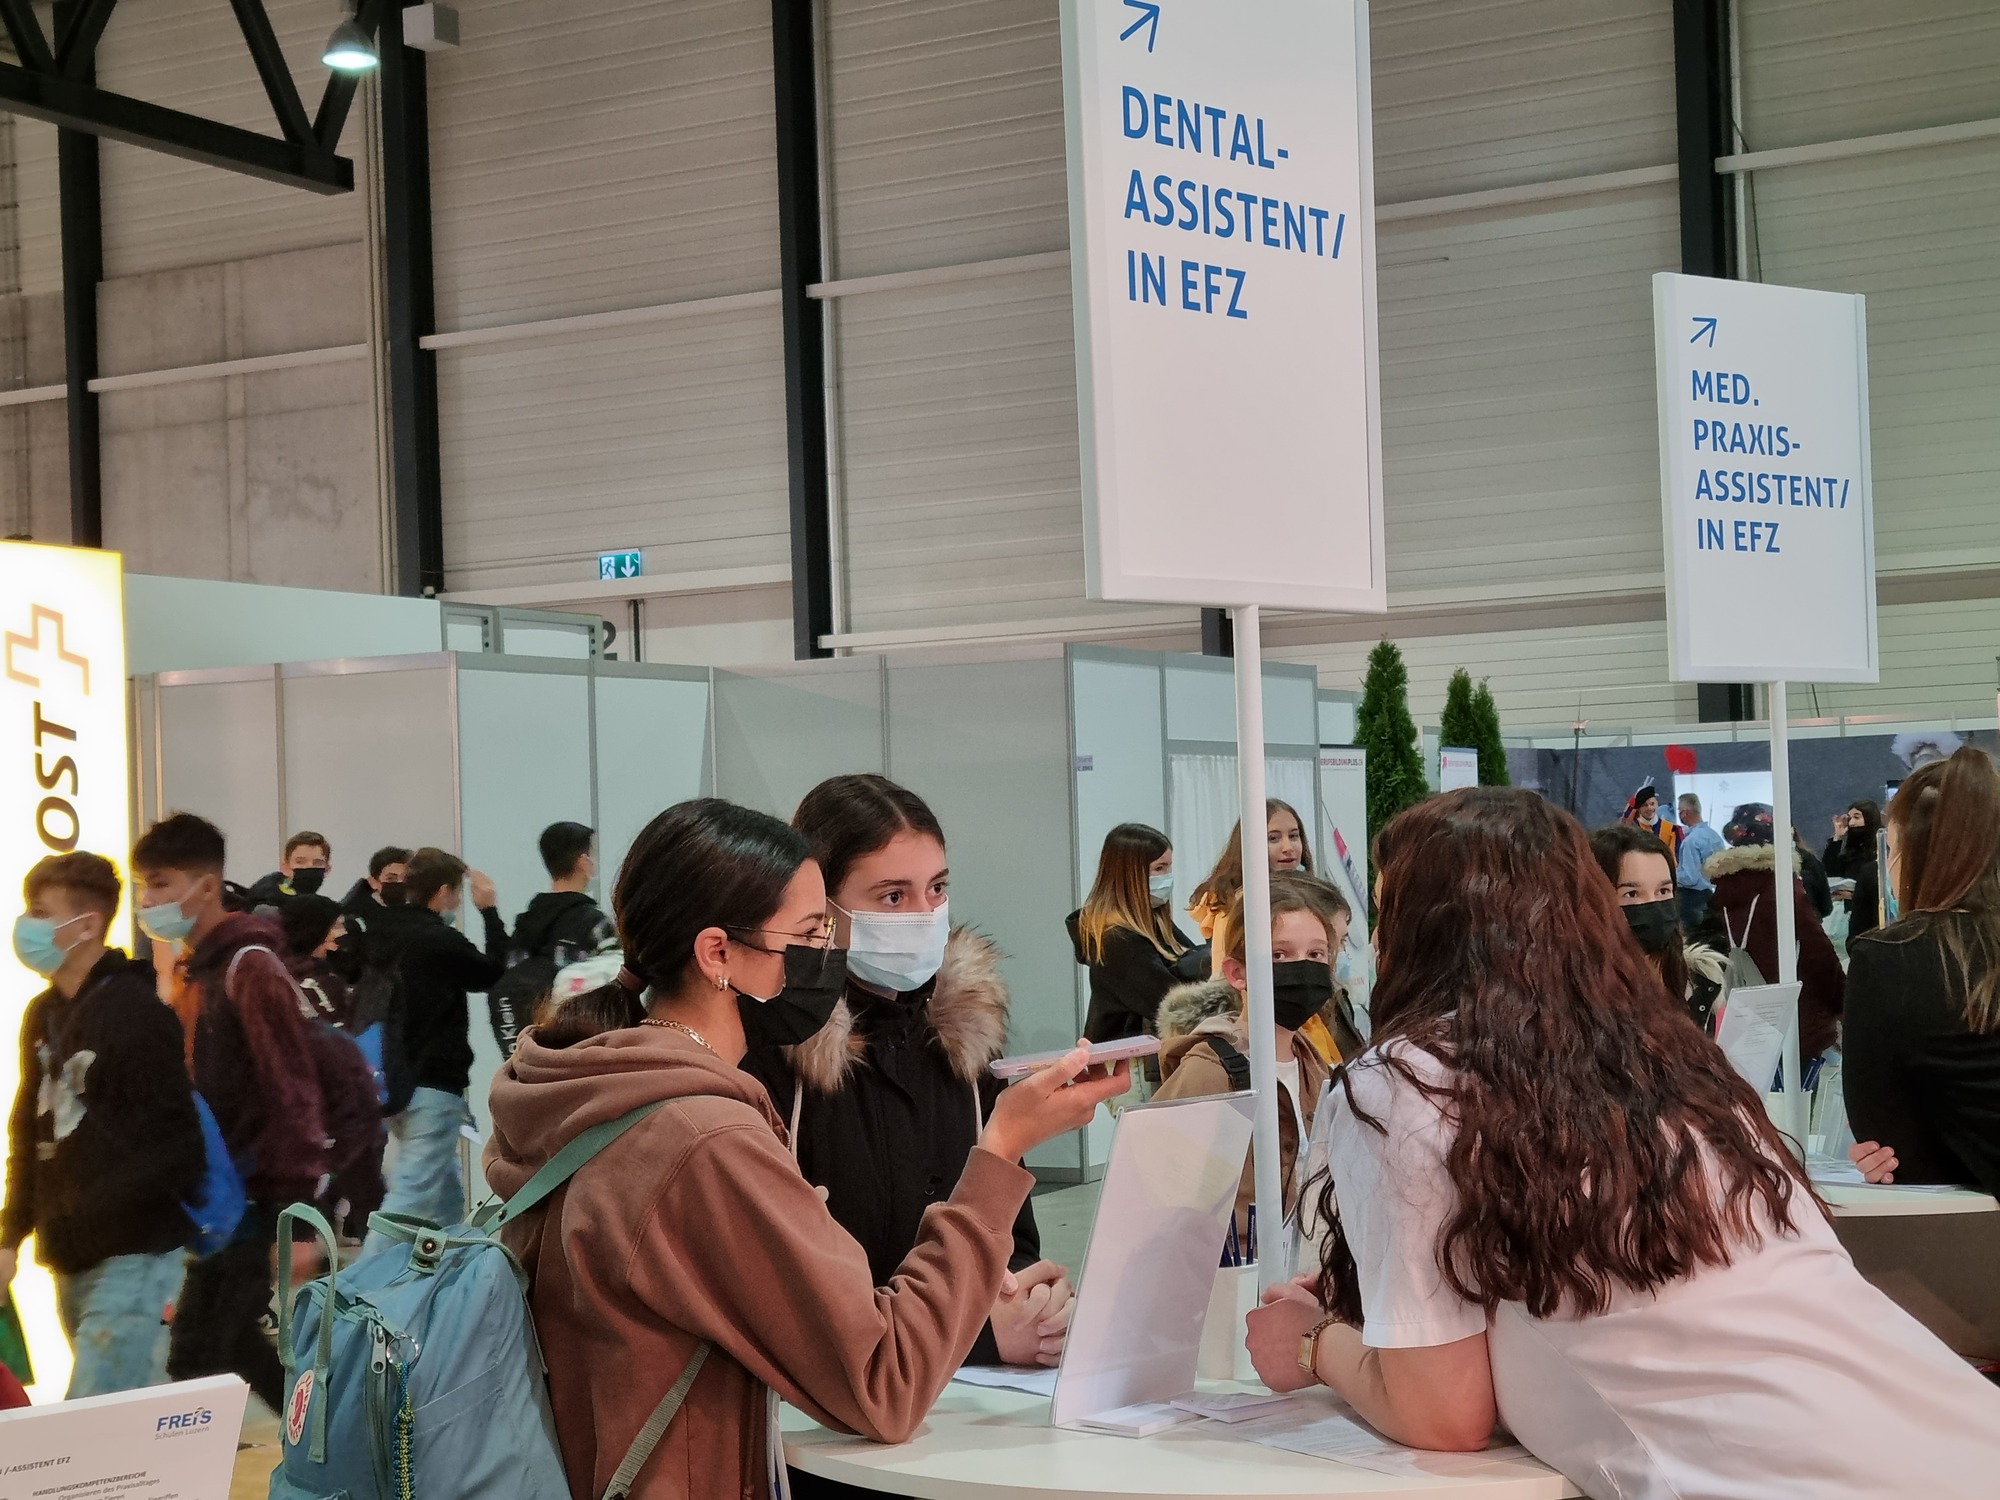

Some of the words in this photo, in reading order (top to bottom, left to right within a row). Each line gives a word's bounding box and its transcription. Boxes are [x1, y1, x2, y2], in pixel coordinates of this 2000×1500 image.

[1122, 85, 1289, 170] DENTAL-
[1124, 169, 1346, 260] ASSISTENT/
[1128, 249, 1166, 307] IN
[1181, 259, 1248, 320] EFZ
[1692, 369, 1760, 407] MED.
[1694, 419, 1801, 457] PRAXIS-
[1695, 468, 1850, 509] ASSISTENT/
[1697, 517, 1724, 551] IN
[1734, 520, 1781, 553] EFZ
[33, 700, 80, 853] OST
[56, 1456, 71, 1465] EFZ
[103, 1485, 115, 1493] des
